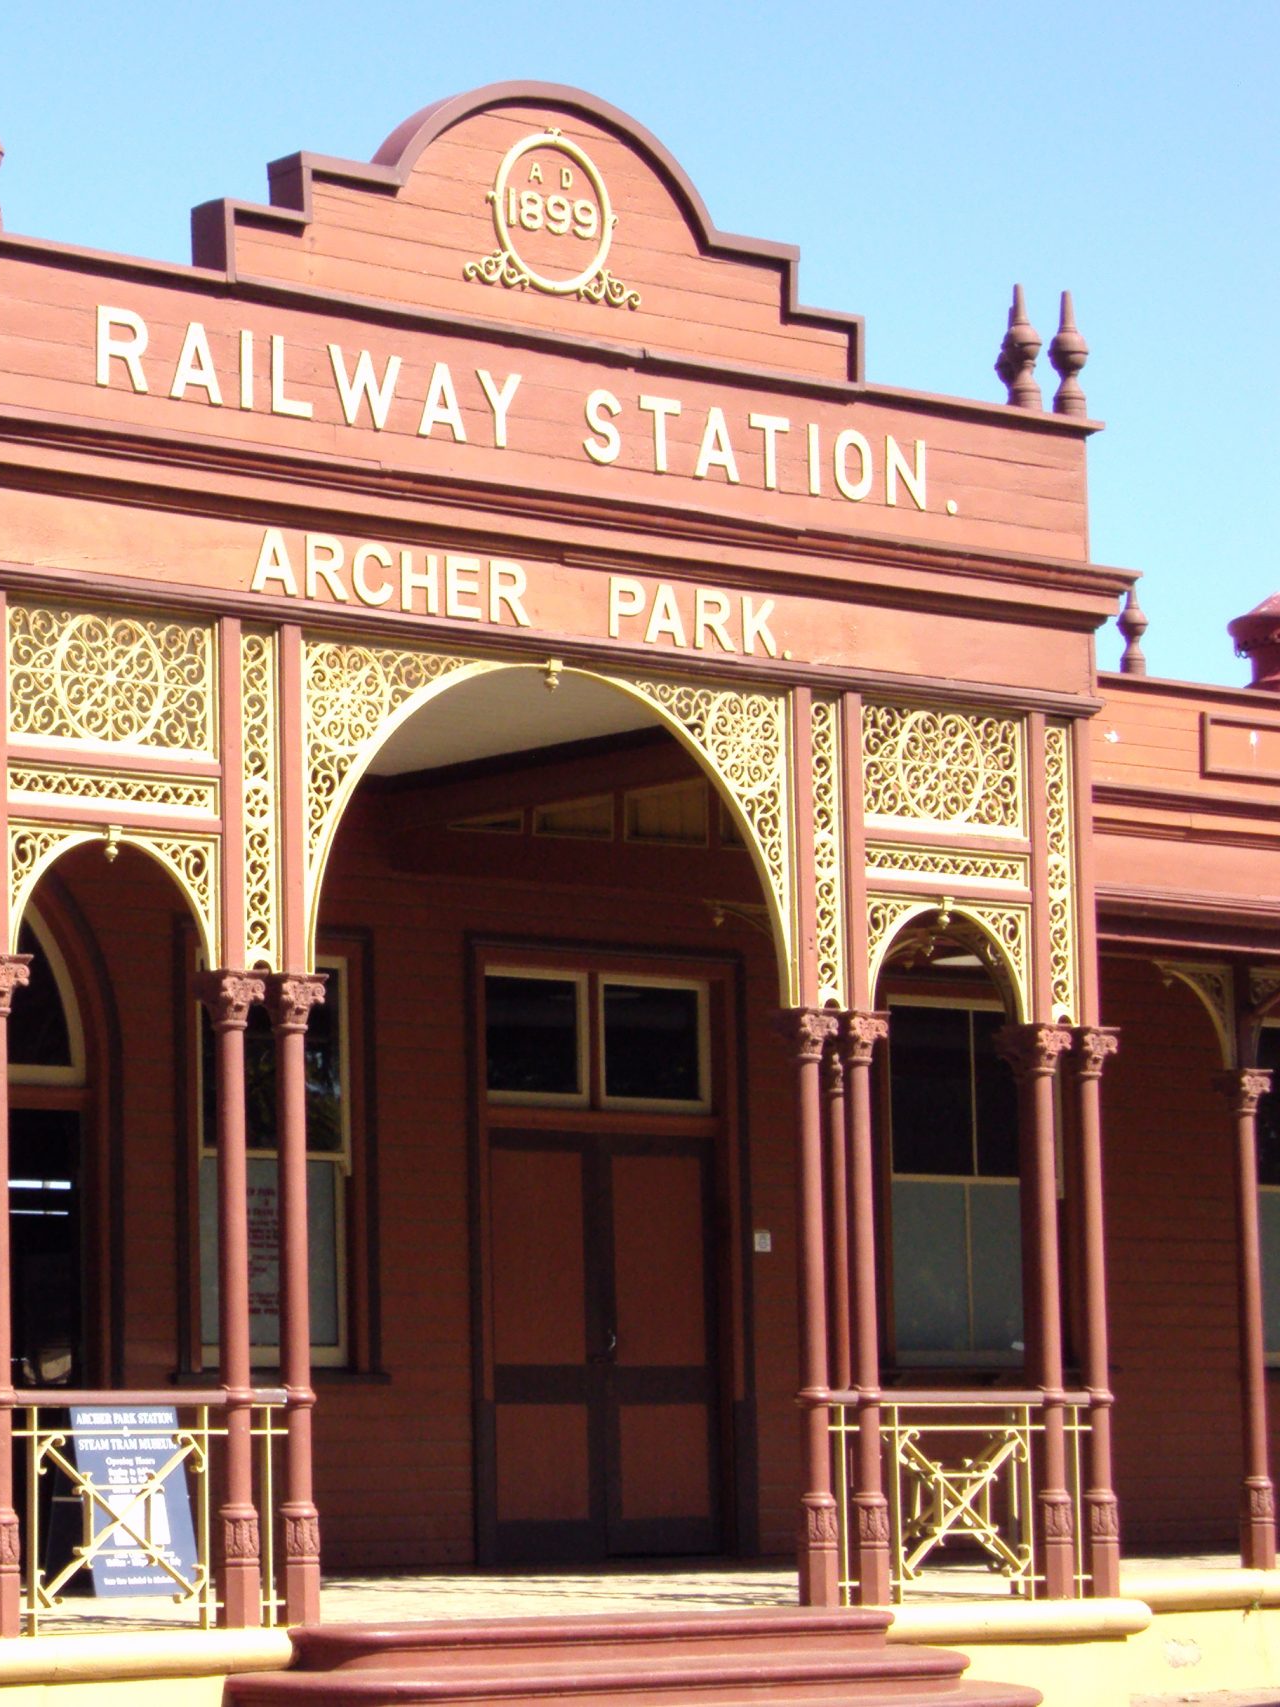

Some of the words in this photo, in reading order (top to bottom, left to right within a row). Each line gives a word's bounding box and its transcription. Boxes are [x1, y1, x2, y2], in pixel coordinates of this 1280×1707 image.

[528, 162, 543, 184] A
[560, 168, 574, 190] D
[506, 187, 597, 240] 1899
[95, 304, 522, 450] RAILWAY
[582, 387, 959, 515] STATION.
[249, 527, 531, 628] ARCHER
[609, 575, 794, 661] PARK.
[76, 1413, 113, 1425] ARCHER
[113, 1413, 137, 1425] PARK
[137, 1413, 173, 1425] STATION
[78, 1438, 110, 1451] STEAM
[110, 1438, 139, 1450] TRAM
